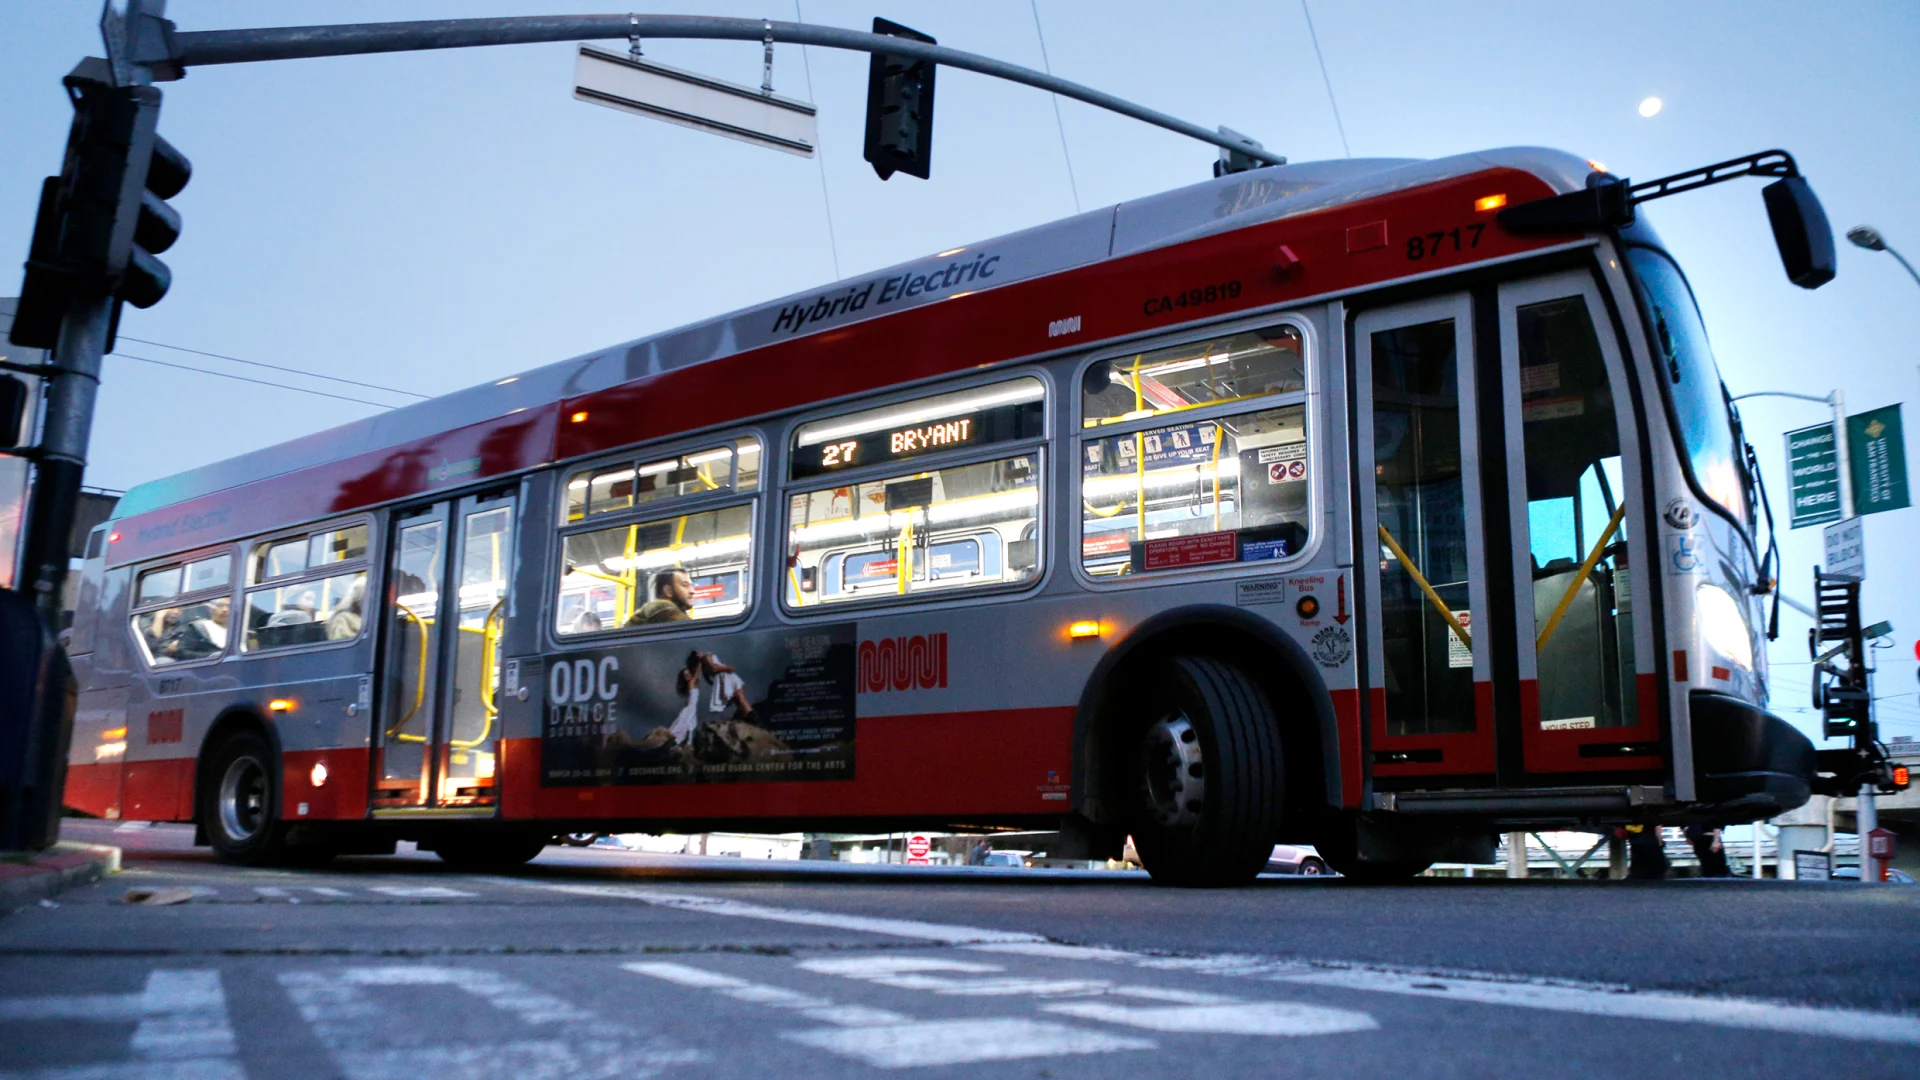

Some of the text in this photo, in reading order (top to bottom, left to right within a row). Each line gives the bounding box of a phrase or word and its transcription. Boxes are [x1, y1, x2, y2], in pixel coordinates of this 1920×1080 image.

[1407, 223, 1486, 261] 8717
[772, 253, 1000, 334] Hybrid Electric
[1143, 280, 1242, 317] CA49819
[1134, 424, 1194, 437] SERVED SEATING
[822, 419, 971, 466] 27 BRYANT
[1791, 433, 1833, 449] CHANGE
[1153, 452, 1168, 461] GIVE
[1176, 448, 1194, 456] YOUR
[1877, 437, 1890, 488] UNIVERSITY
[1793, 462, 1836, 476] WORLD
[1868, 459, 1880, 503] FRANCISCO
[1796, 491, 1836, 507] HERE
[1289, 576, 1324, 585] Kneeling
[1457, 616, 1471, 624] STOP
[1311, 626, 1334, 644] Thank
[1339, 628, 1351, 643] You
[550, 656, 619, 704] ODC
[550, 701, 617, 725] DANCE
[1570, 721, 1590, 729] STEP
[727, 763, 753, 772] BUENA
[755, 762, 784, 772] CENTER
[788, 761, 803, 770] FOR
[805, 761, 821, 770] THE
[824, 760, 846, 770] ARTS
